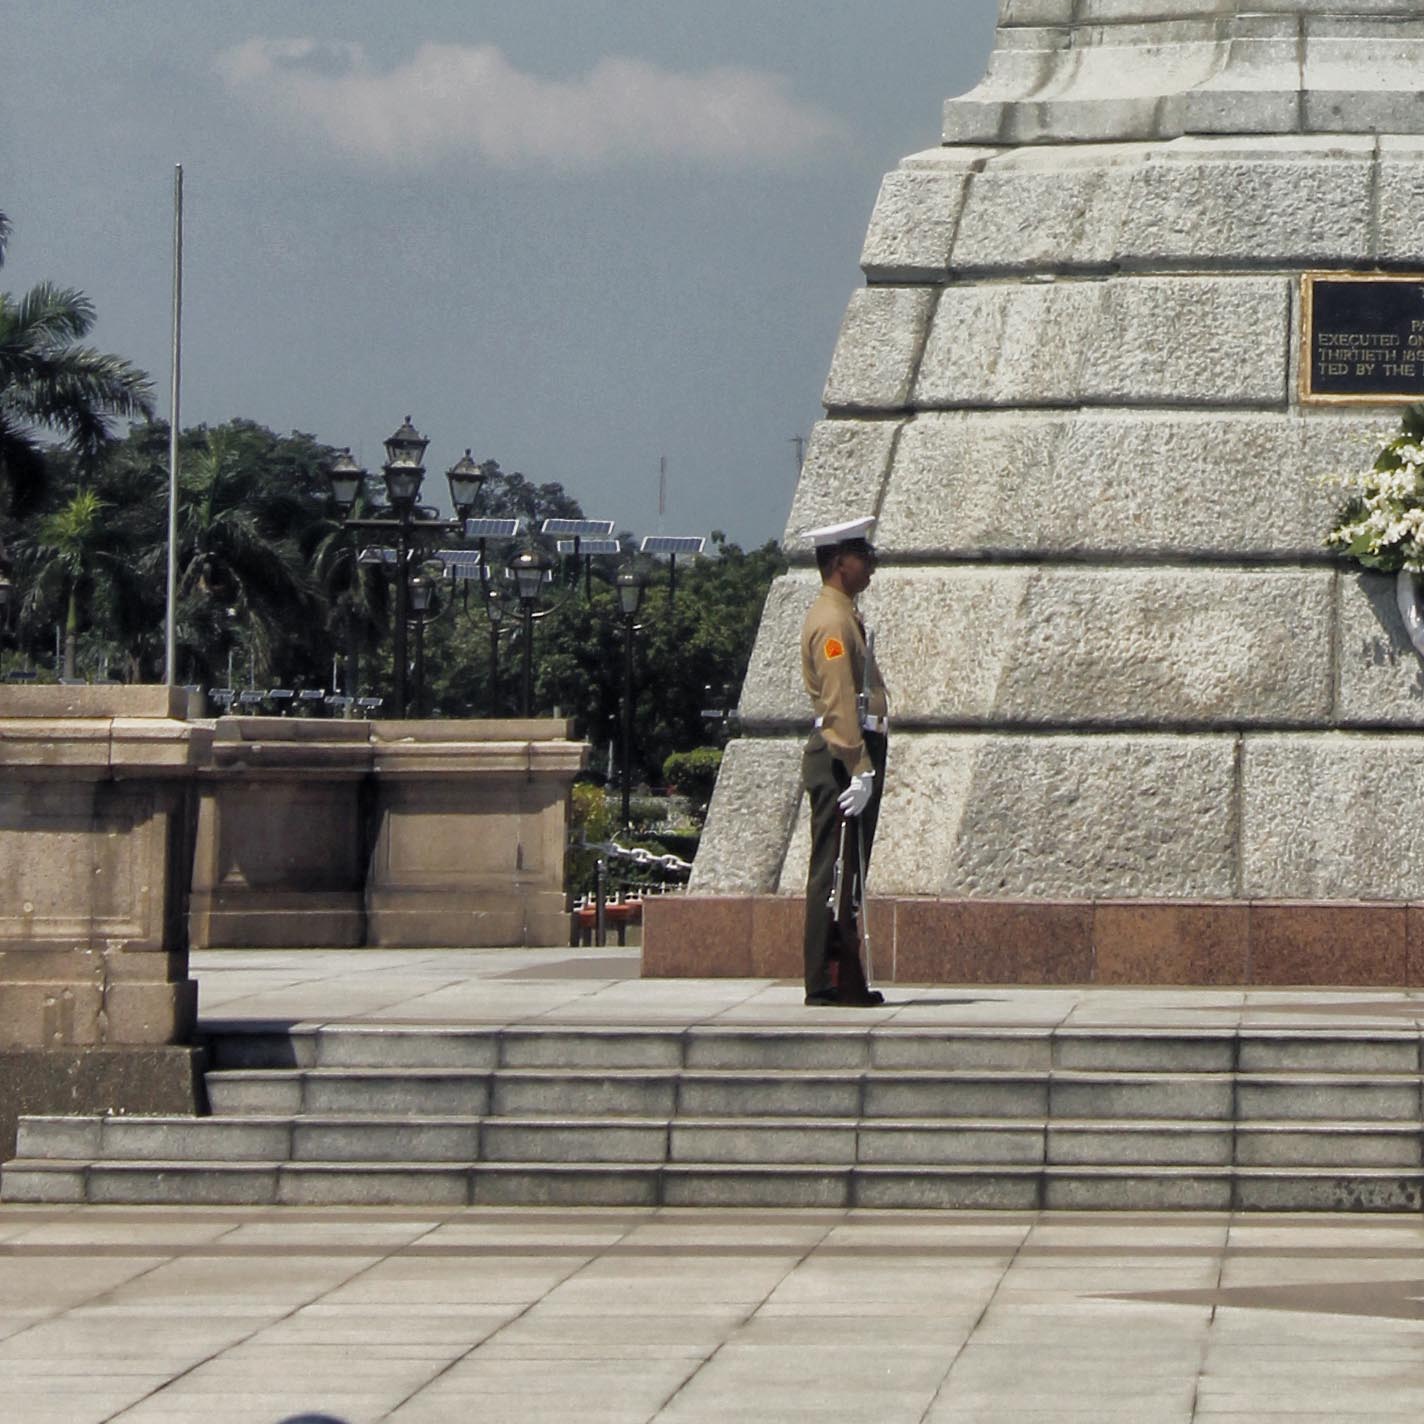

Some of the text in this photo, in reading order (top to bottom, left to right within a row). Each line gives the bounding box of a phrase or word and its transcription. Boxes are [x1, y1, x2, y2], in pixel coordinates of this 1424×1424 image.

[1318, 333, 1400, 347] EXECUTED
[1318, 348, 1397, 361] THIRTIETH
[1318, 362, 1349, 376] TED
[1356, 363, 1375, 376] BY
[1382, 364, 1416, 377] THE
